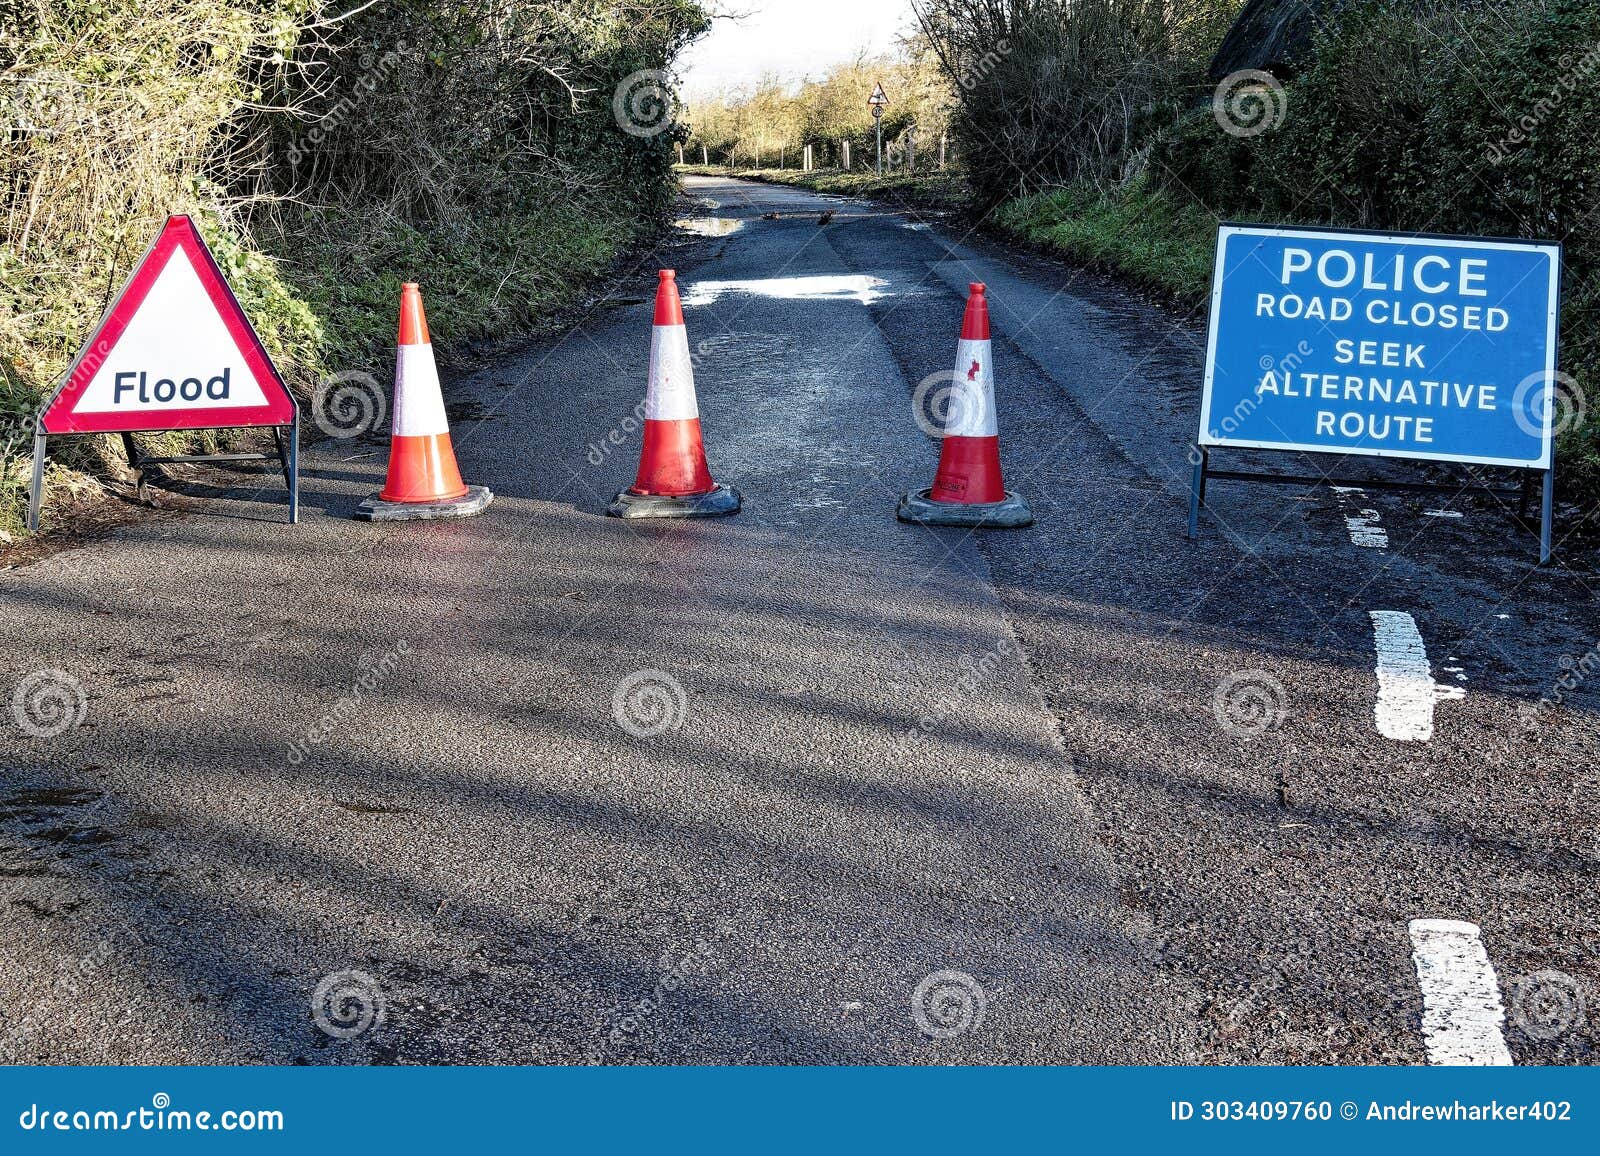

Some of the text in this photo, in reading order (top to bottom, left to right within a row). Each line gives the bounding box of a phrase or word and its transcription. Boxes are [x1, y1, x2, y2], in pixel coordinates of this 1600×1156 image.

[1281, 248, 1488, 297] POLICE
[1256, 293, 1509, 331] ROAD CLOSED
[1334, 339, 1425, 368] SEEK
[113, 367, 231, 404] Flood
[1257, 371, 1497, 410] ALTERNATIVE
[1316, 411, 1433, 443] ROUTE
